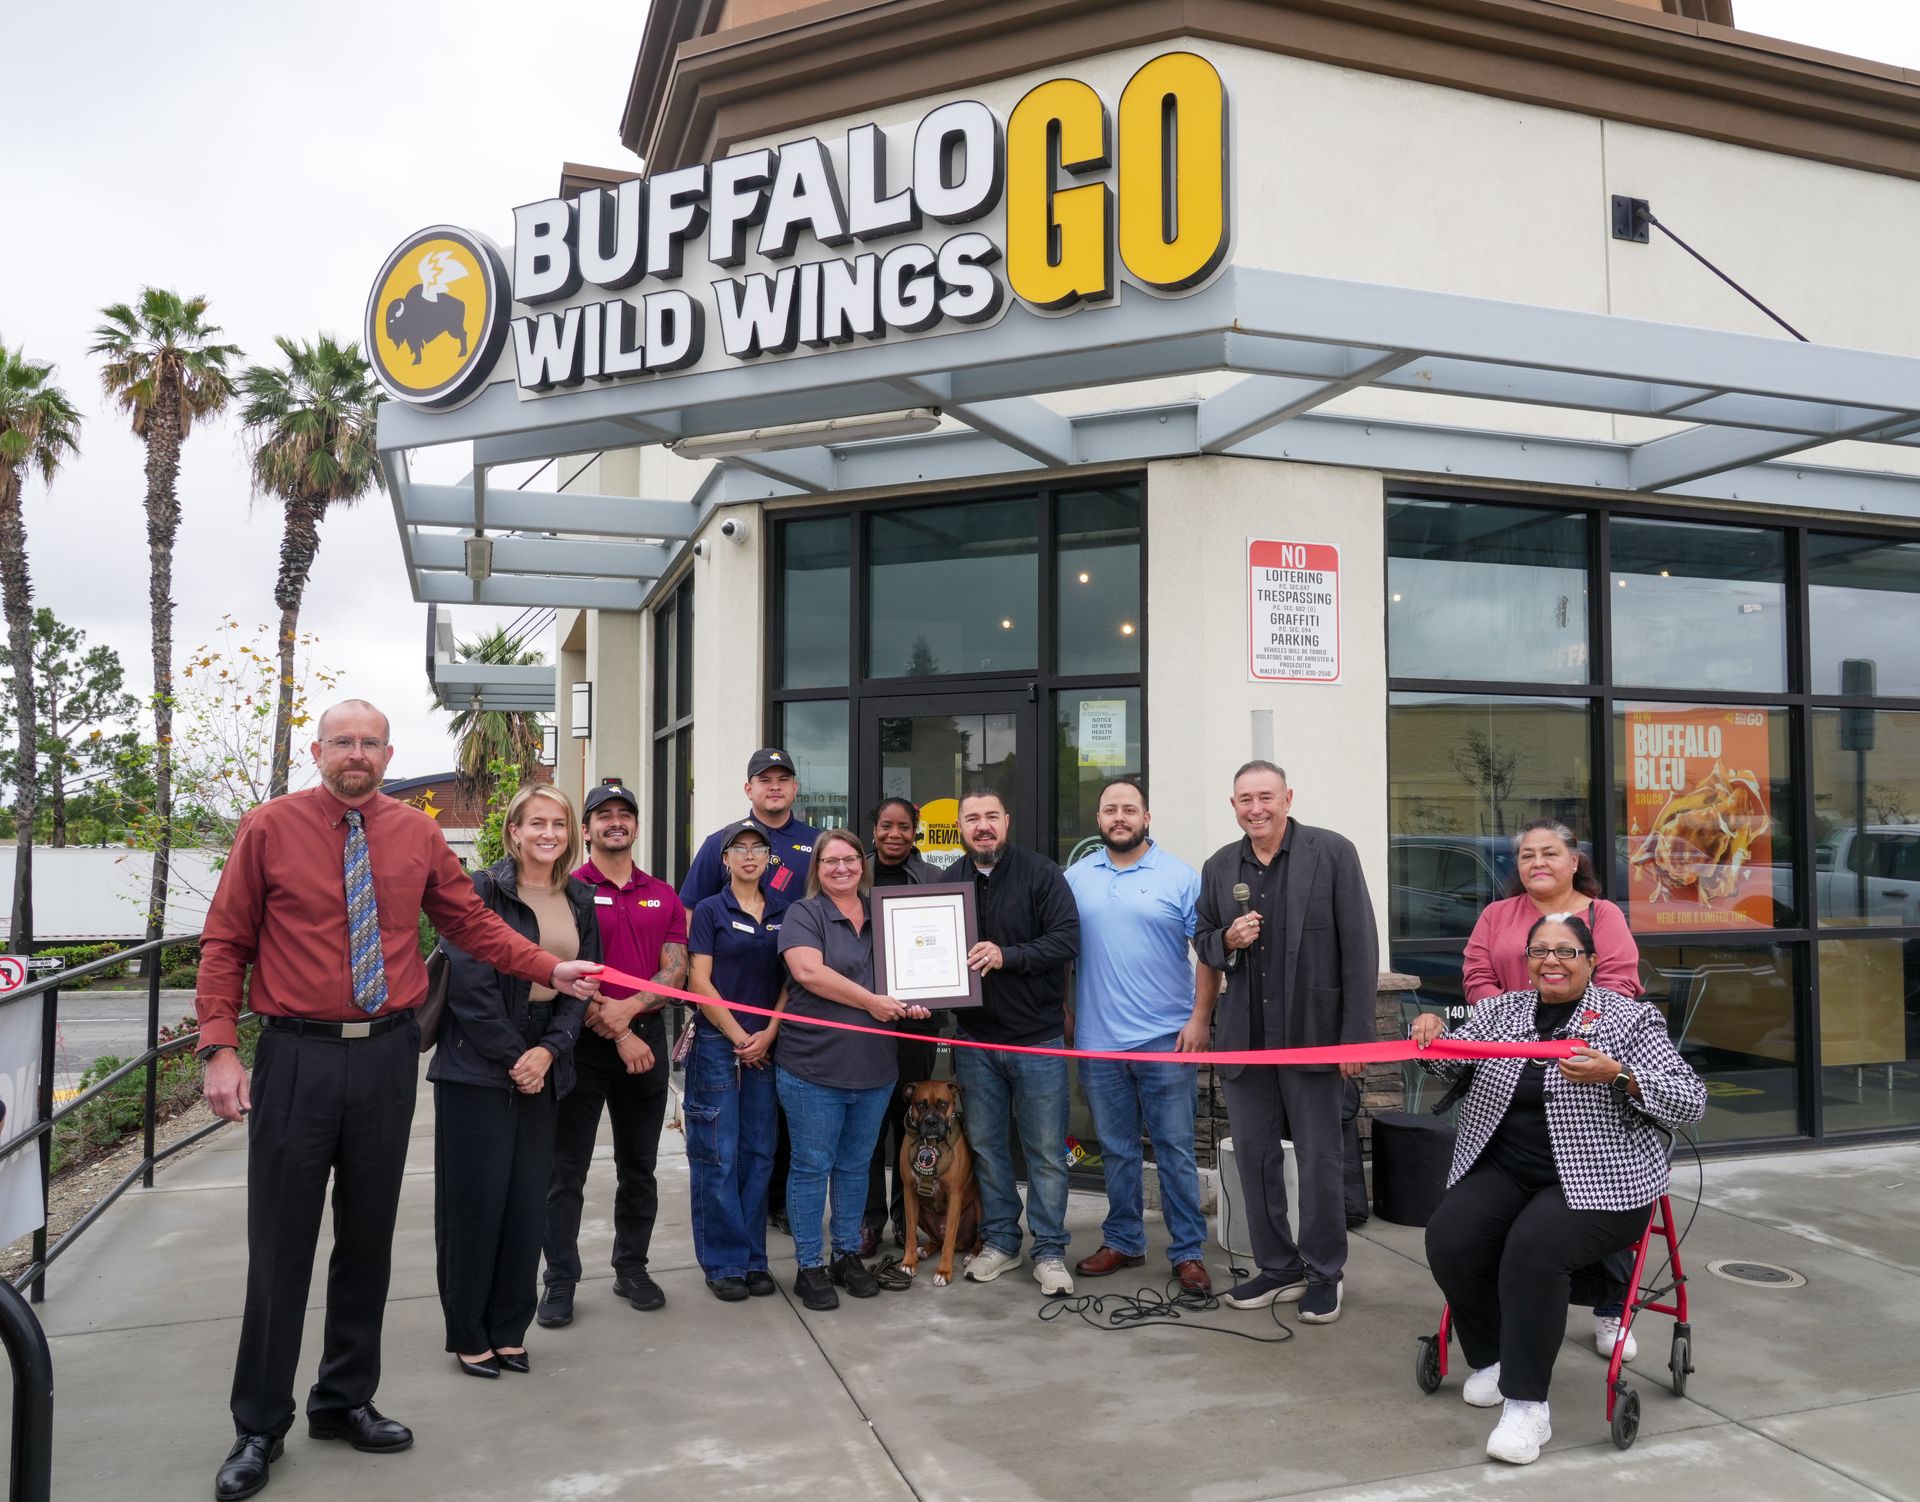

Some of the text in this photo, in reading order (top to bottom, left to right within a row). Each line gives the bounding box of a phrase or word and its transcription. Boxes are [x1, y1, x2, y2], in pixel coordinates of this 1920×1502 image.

[1006, 51, 1230, 308] GO
[512, 100, 1003, 304] BUFFALO
[510, 232, 1002, 390] WILD WINGS
[1281, 544, 1307, 569] NO
[1265, 569, 1323, 585] LOITERING
[1257, 589, 1332, 606] TRESPASSING
[1270, 612, 1320, 627] GRAFFITI
[1271, 633, 1320, 647] PARKING
[1747, 713, 1764, 726] GO
[1634, 723, 1721, 758] BUFFALO
[1634, 757, 1685, 791] BLEU
[929, 829, 961, 844] REWA
[801, 845, 812, 853] GO
[927, 853, 961, 864] More Point
[1657, 910, 1747, 924] HERE FOR A LIMITED TIME
[1444, 1005, 1464, 1019] 140
[1076, 1147, 1081, 1157] 0
